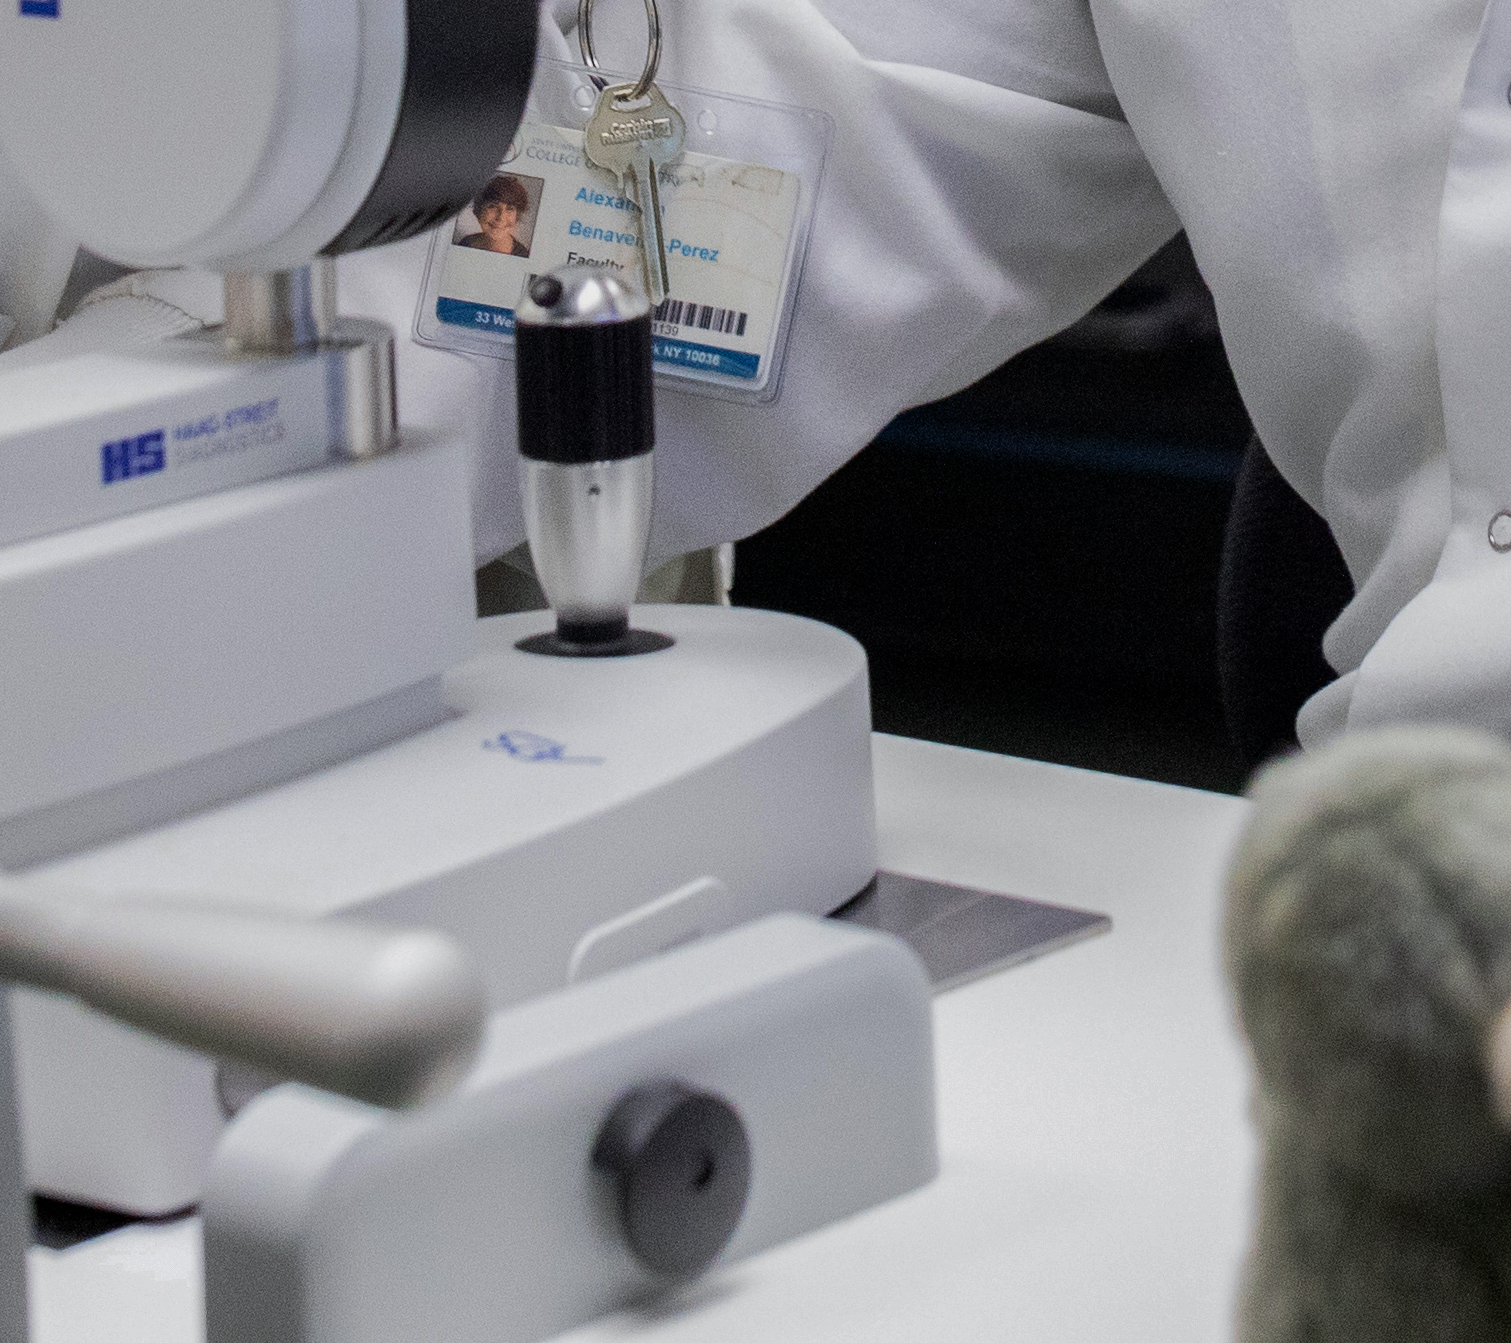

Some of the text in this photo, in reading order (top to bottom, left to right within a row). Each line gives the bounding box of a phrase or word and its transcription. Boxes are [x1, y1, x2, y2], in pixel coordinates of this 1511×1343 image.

[526, 146, 582, 167] COLLEGE
[575, 186, 665, 216] Alexan
[475, 311, 490, 324] 33
[664, 345, 682, 359] NY
[101, 427, 166, 486] HS
